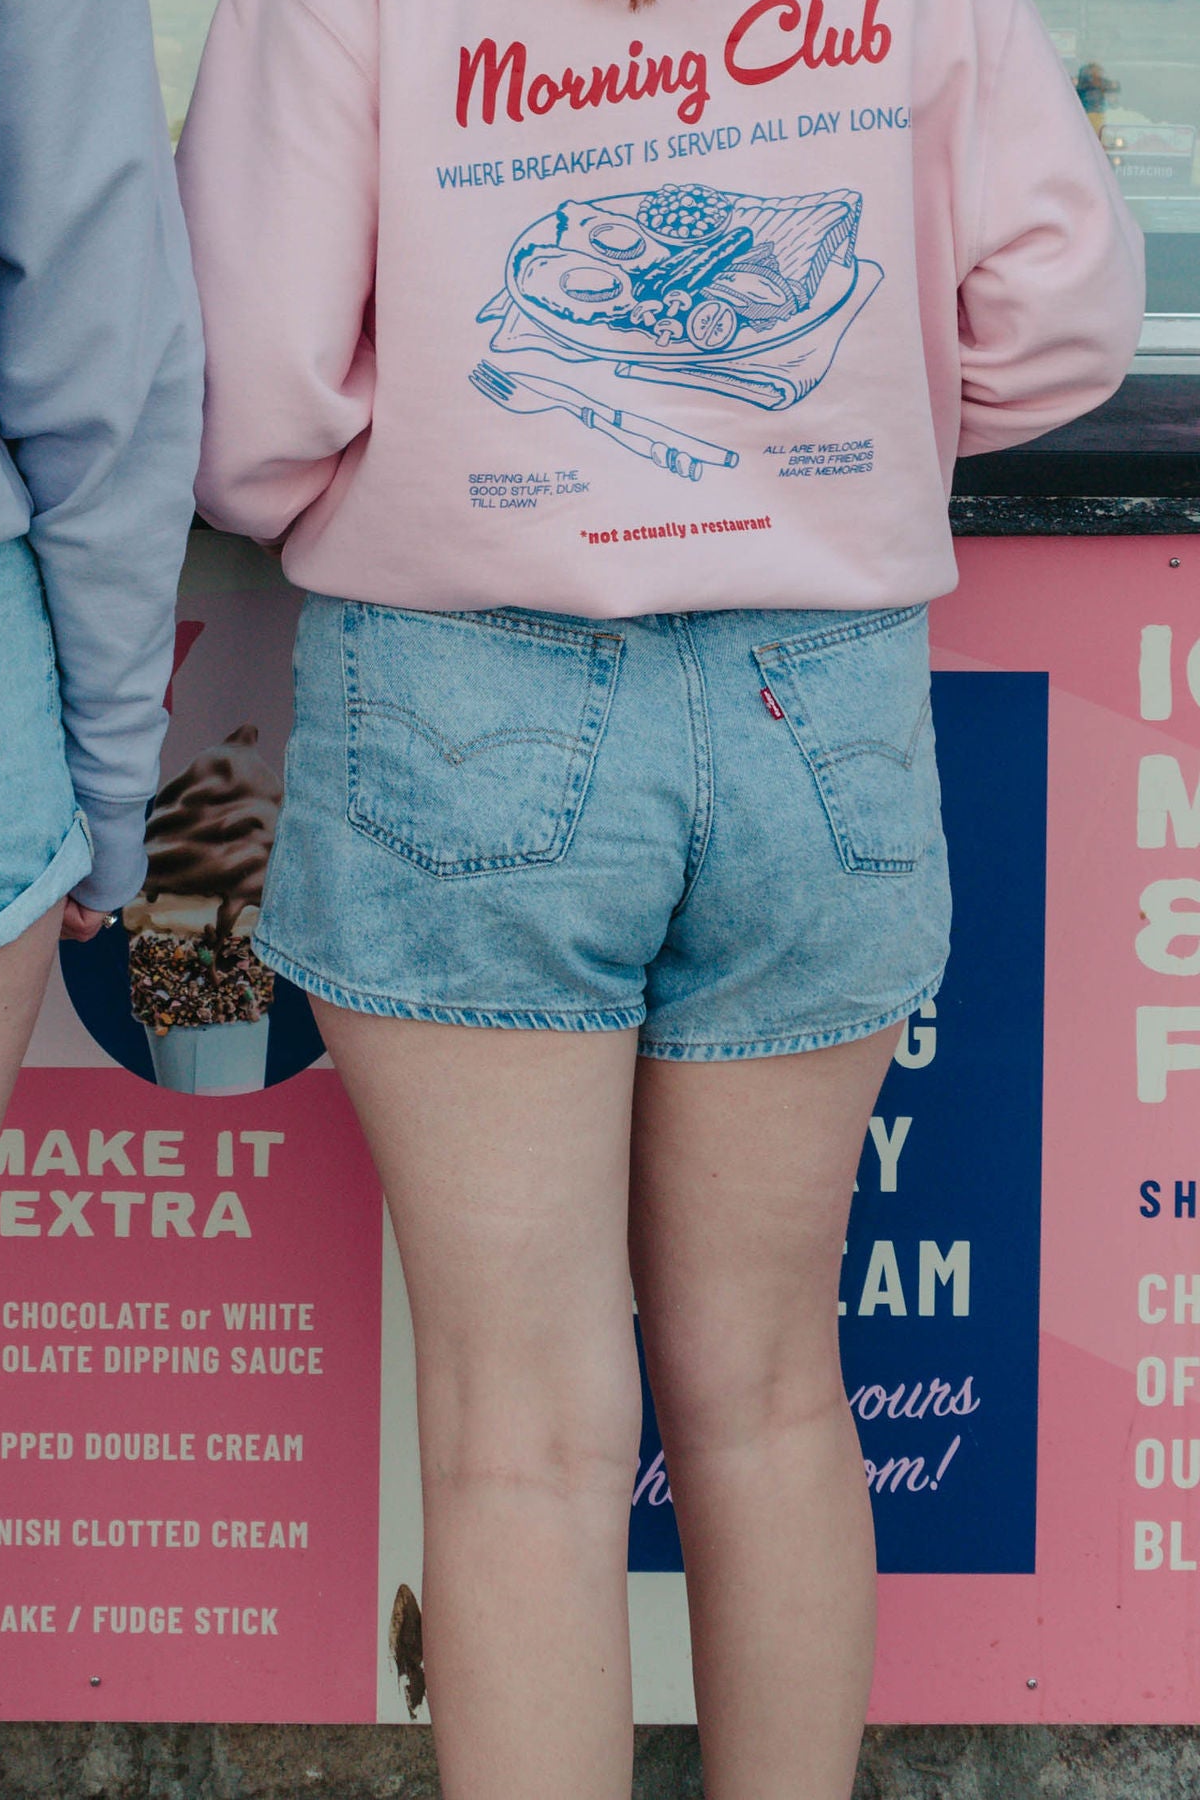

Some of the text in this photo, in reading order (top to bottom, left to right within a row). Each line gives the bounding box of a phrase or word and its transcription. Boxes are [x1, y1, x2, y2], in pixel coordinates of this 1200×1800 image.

[456, 37, 711, 128] Morning
[437, 162, 505, 189] WHERE
[512, 143, 634, 181] BREAKFAST
[644, 139, 659, 162] IS
[667, 126, 742, 160] SERVED
[750, 120, 788, 145] ALL
[799, 112, 840, 138] DAY
[763, 445, 786, 454] ALL
[788, 451, 874, 465] BRING FRIENDS
[468, 470, 579, 484] SERVING ALL THE
[779, 462, 873, 477] MAKE MEMORIES
[469, 486, 507, 496] GOOD
[556, 482, 591, 495] DUSK
[470, 498, 537, 509] TILL DAWN
[623, 522, 687, 543] actually
[690, 524, 700, 536] a
[701, 515, 772, 535] restaurant
[217, 1130, 285, 1178] IT
[0, 1190, 252, 1238] EXTRA
[838, 1240, 971, 1317] AM
[2, 1302, 170, 1330] CHOCOLATE
[181, 1307, 211, 1331] or
[222, 1302, 315, 1332] WHITE
[104, 1346, 220, 1374] DIPPING
[231, 1346, 324, 1375] SAUCE
[85, 1432, 196, 1461] DOUBLE
[206, 1433, 304, 1462] CREAM
[72, 1519, 200, 1548] CLOTTED
[212, 1520, 309, 1549] CREAM
[93, 1606, 183, 1634] FUDGE
[194, 1607, 279, 1636] STICK
